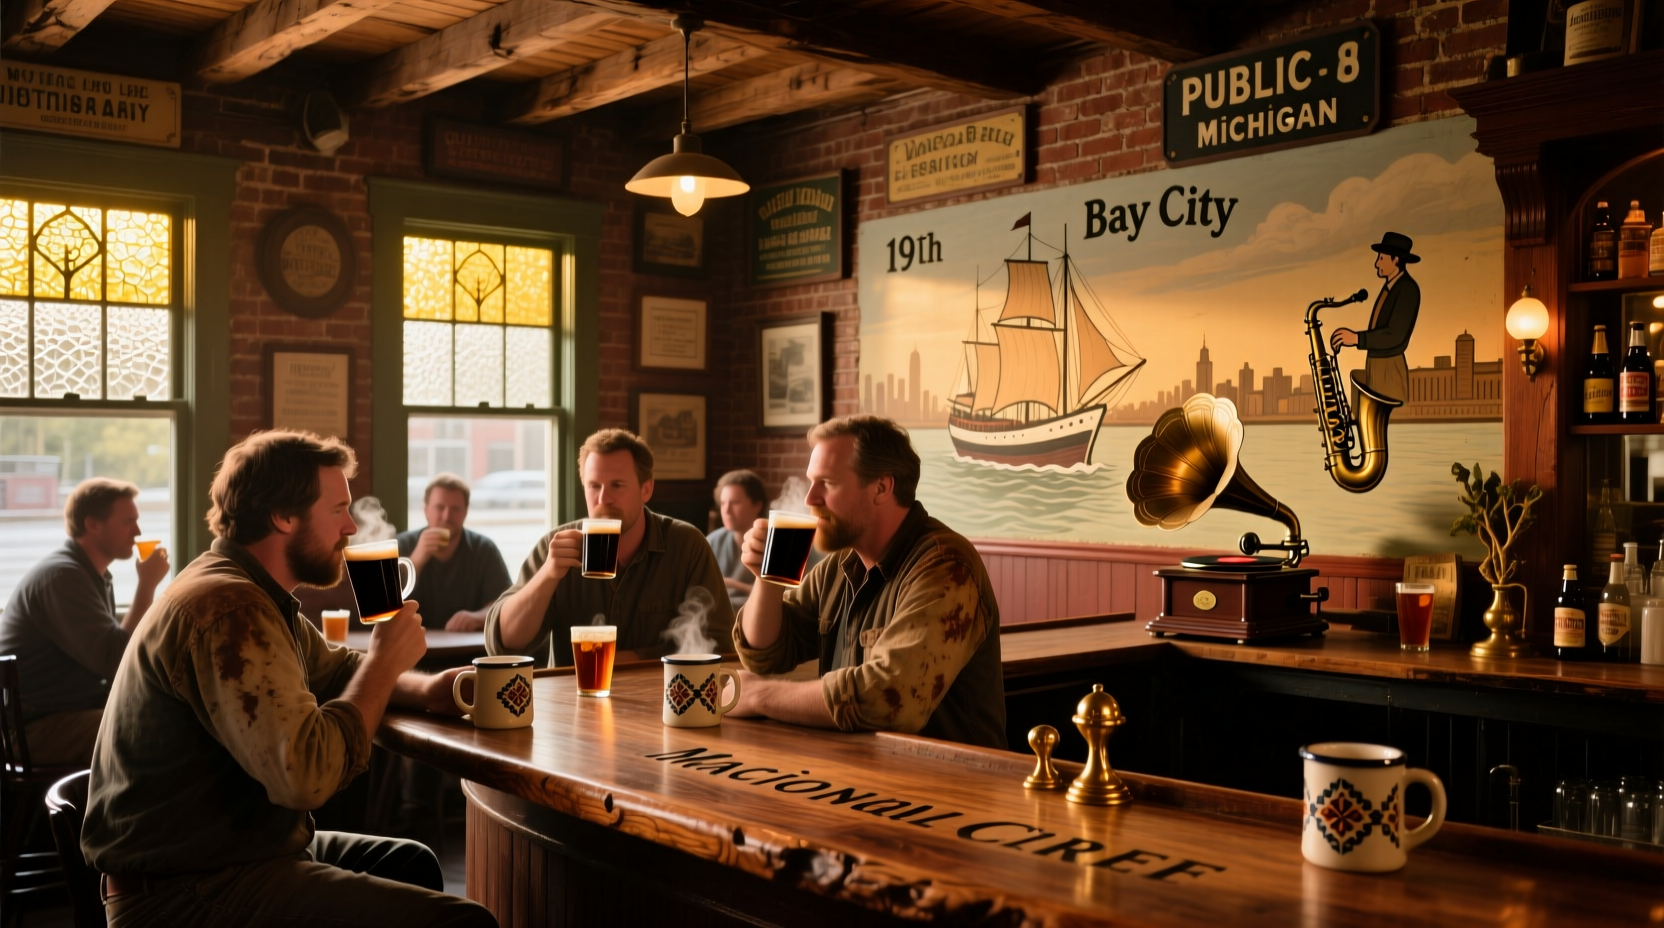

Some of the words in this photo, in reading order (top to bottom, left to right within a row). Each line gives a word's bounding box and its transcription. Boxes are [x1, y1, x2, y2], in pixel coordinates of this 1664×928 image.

[1182, 50, 1312, 117] PUBLIC
[1336, 41, 1360, 84] 8
[1083, 199, 1152, 242] Bay
[1159, 184, 1239, 238] City
[886, 232, 943, 273] 19th
